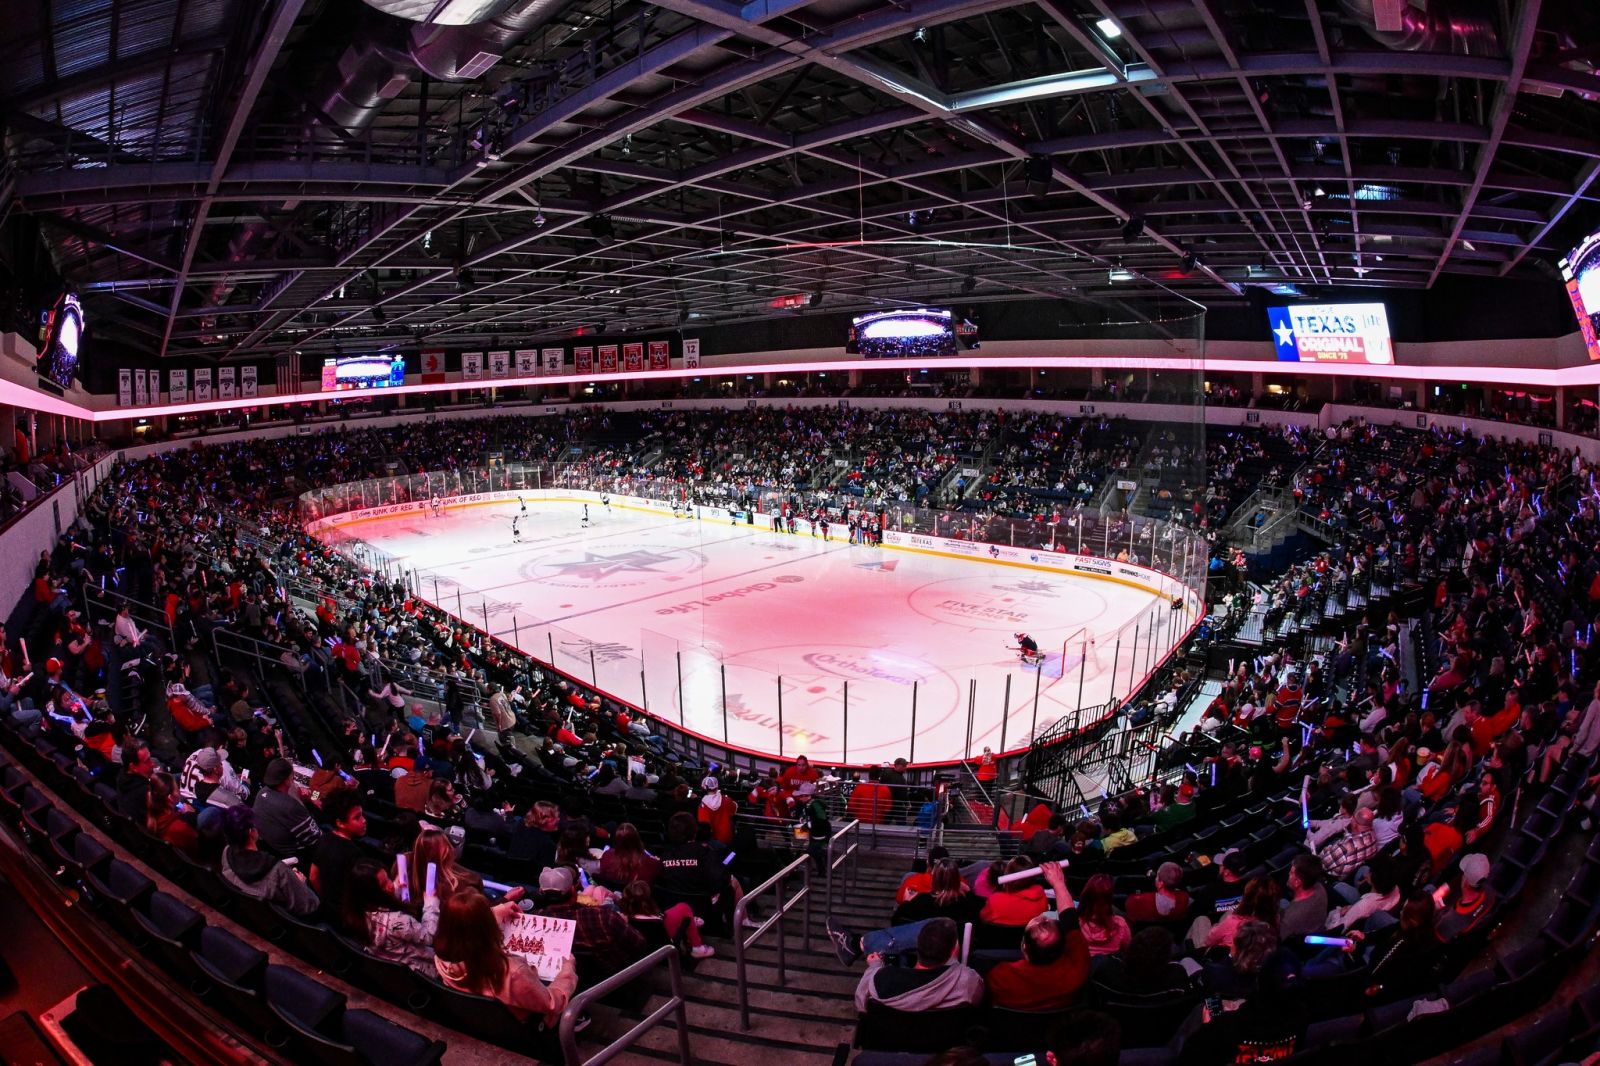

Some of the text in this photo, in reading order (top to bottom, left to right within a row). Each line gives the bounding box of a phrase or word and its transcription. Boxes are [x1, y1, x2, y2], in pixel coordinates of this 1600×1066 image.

[1294, 315, 1357, 333] TEXAS
[686, 345, 696, 354] 12
[1298, 336, 1364, 353] ORIGINAL
[1317, 352, 1338, 360] SINCE
[687, 360, 697, 369] 30
[469, 494, 482, 502] RED
[372, 507, 388, 516] RINK
[390, 505, 399, 513] OF
[401, 504, 414, 512] RED
[655, 582, 777, 616] Globe Life
[941, 600, 1029, 619] FIVE STAR
[817, 653, 912, 685] OrthoTexas
[758, 717, 831, 745] LIGHT
[681, 858, 698, 867] TECH
